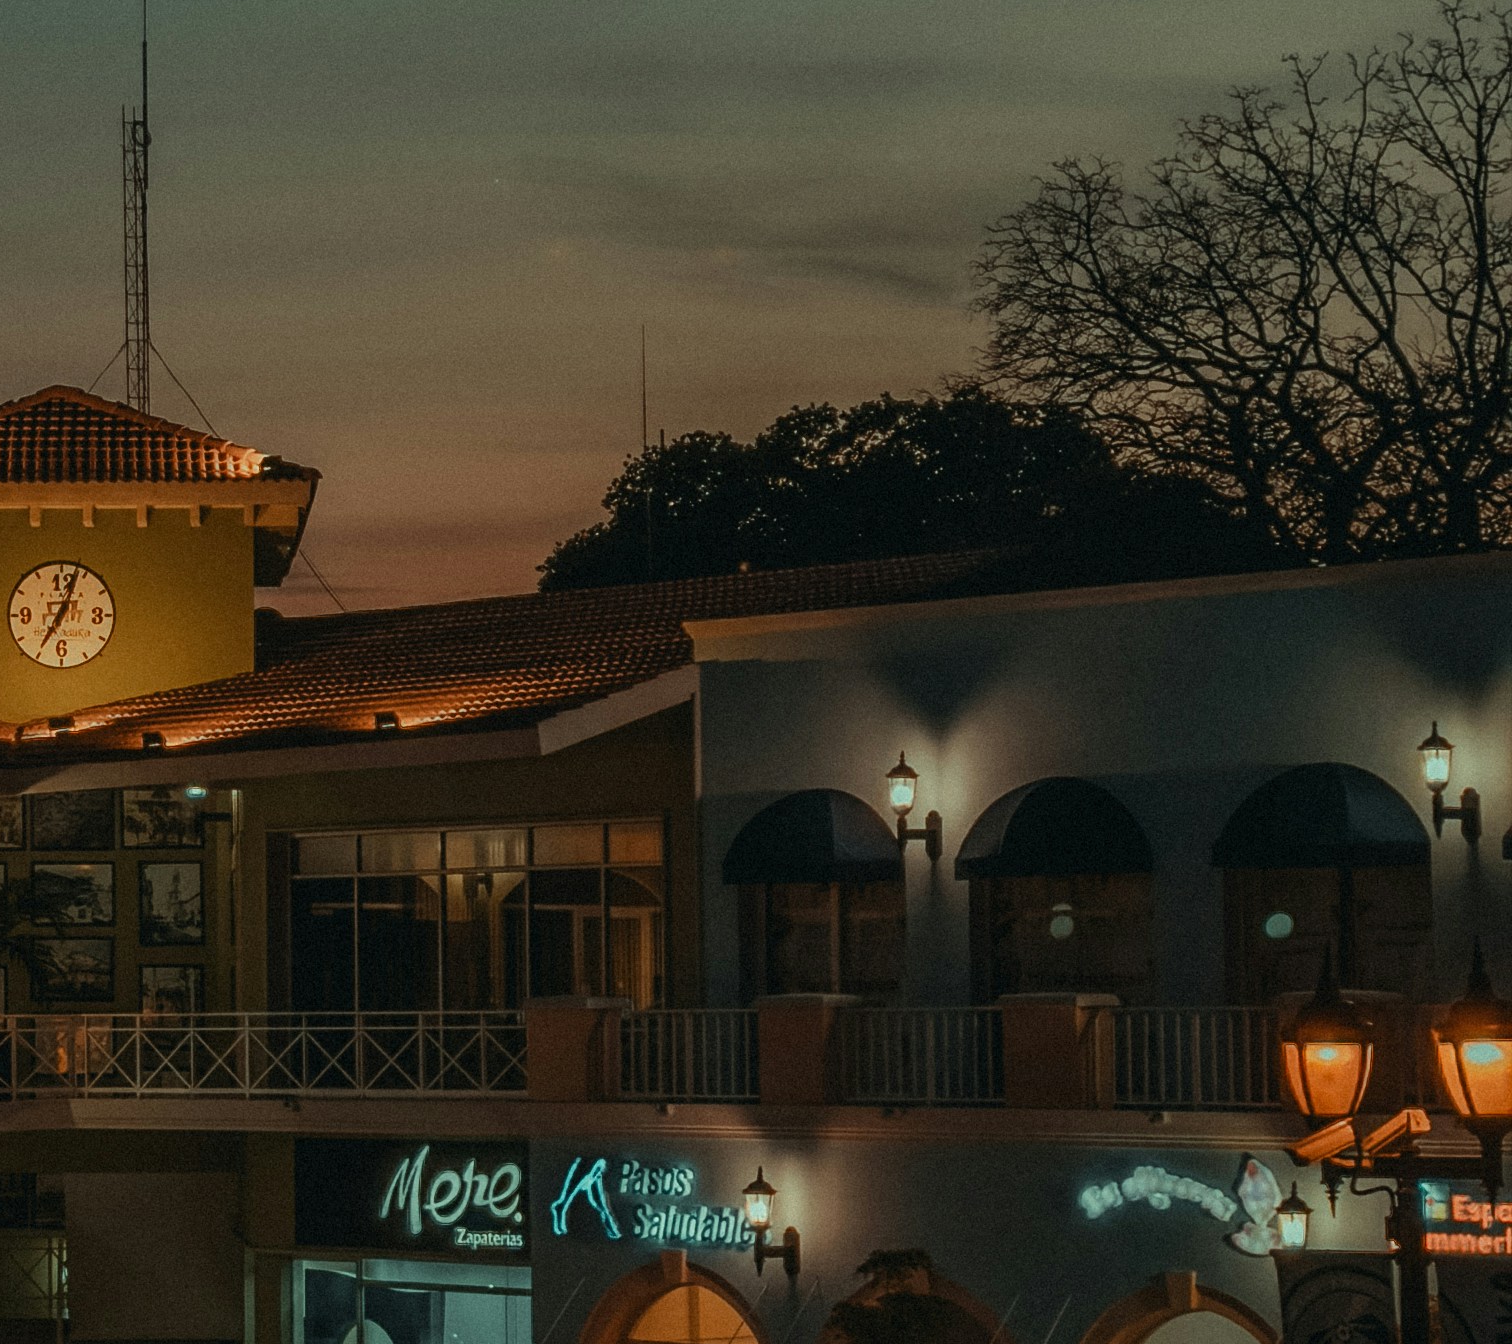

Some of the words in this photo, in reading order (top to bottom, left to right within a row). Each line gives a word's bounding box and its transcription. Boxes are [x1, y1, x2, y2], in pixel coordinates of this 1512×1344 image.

[19, 606, 32, 624] 9
[91, 606, 104, 625] 3
[55, 639, 68, 658] 6
[618, 1159, 694, 1197] Pasos
[632, 1203, 772, 1248] Saludable
